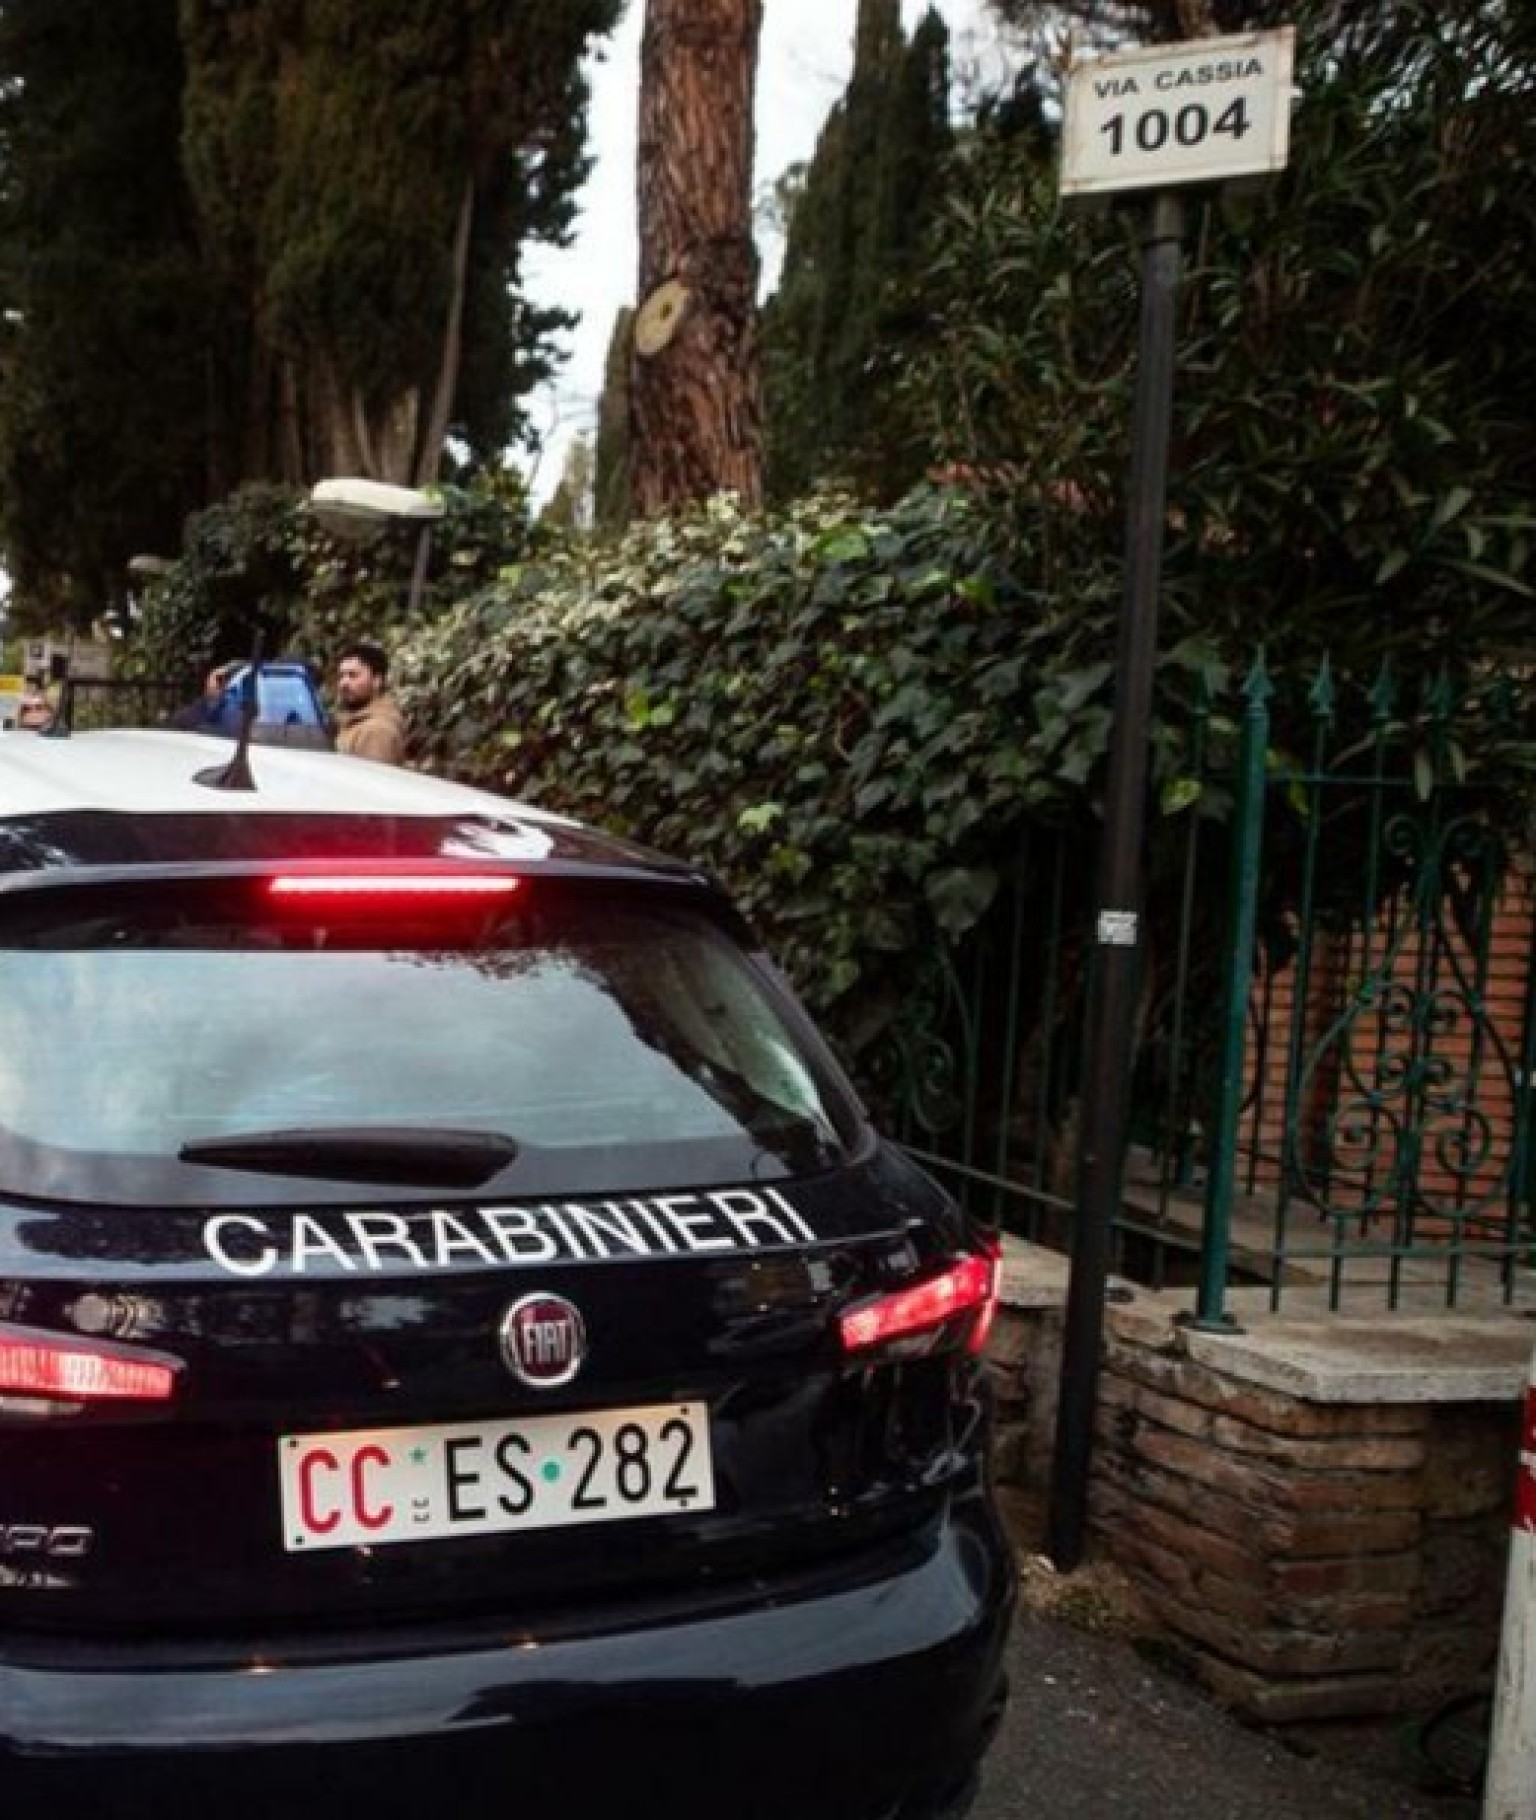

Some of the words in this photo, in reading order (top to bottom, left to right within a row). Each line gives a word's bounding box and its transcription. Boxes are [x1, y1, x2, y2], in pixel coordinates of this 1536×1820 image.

[1093, 76, 1140, 99] VIA
[1154, 57, 1262, 92] CASSIA
[1099, 97, 1252, 156] 1004
[202, 1186, 817, 1276] CARABINIERI
[522, 1318, 575, 1365] FIAT
[297, 1444, 394, 1535] CC
[567, 1419, 698, 1510] 282
